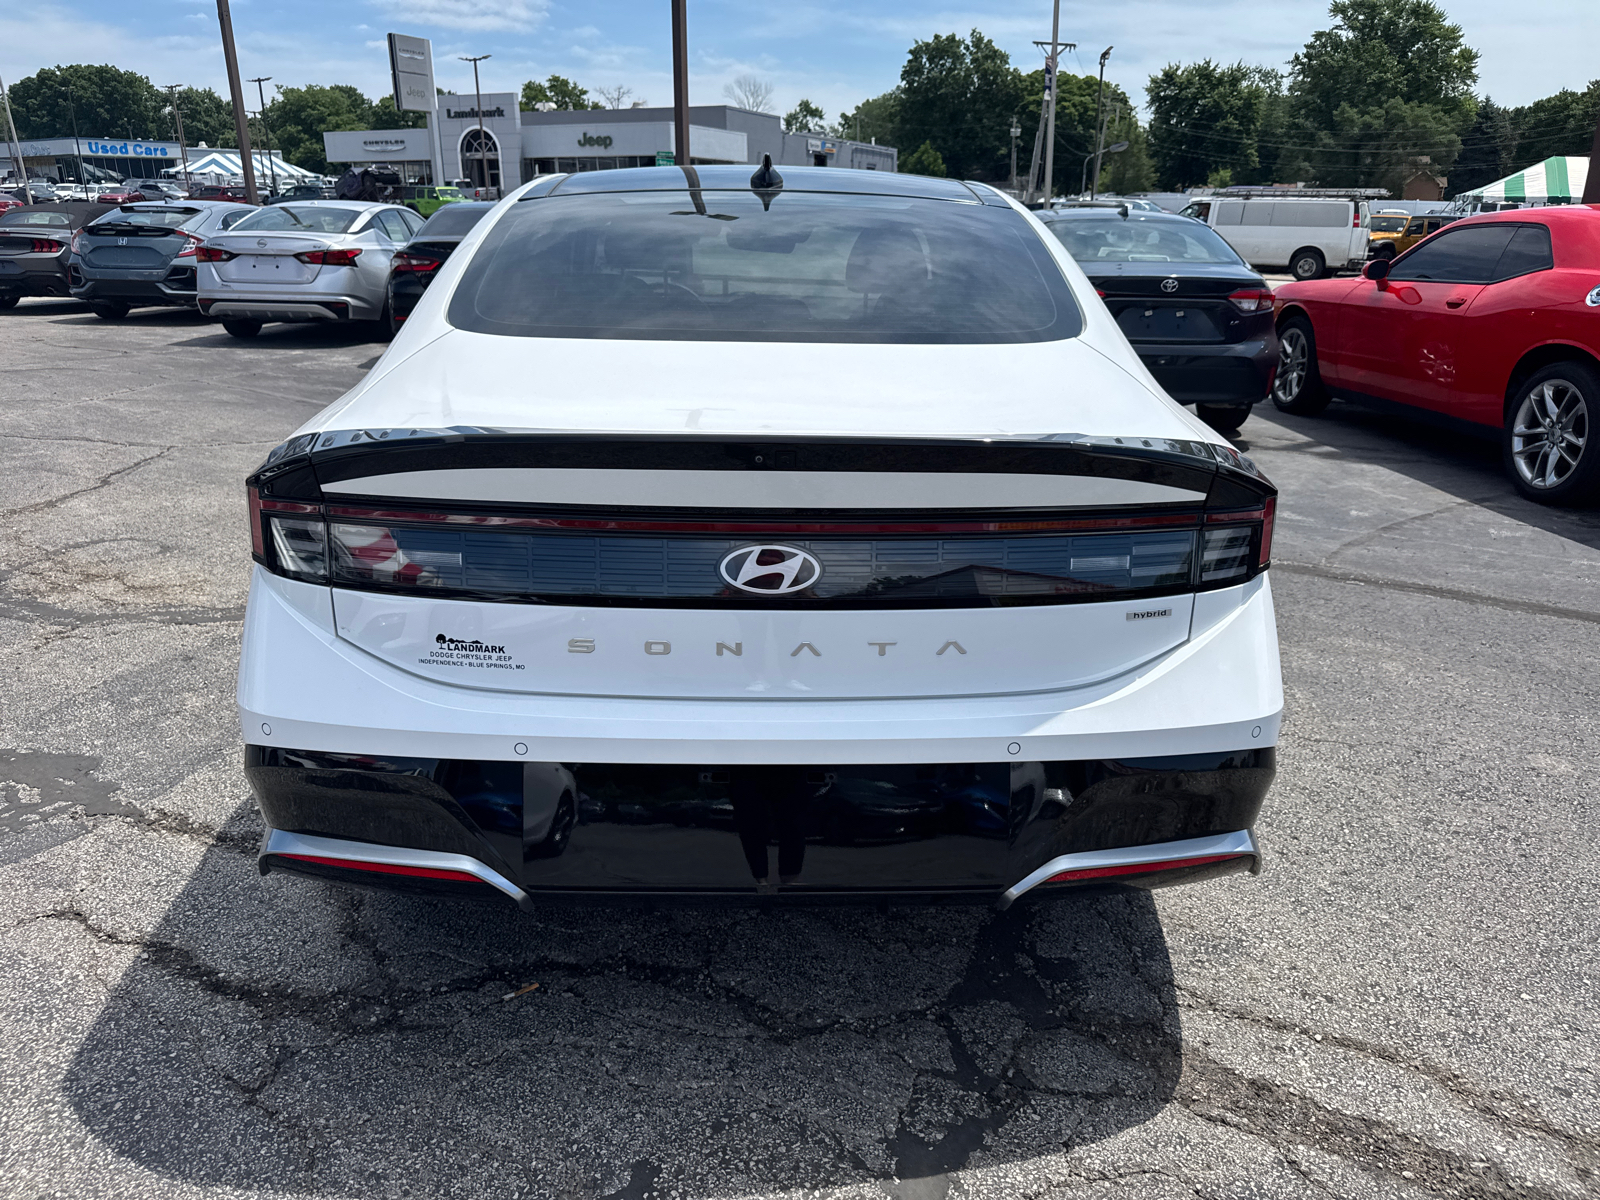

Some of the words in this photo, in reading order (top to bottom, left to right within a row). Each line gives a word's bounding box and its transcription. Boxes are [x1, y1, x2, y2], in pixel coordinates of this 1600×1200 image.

[406, 86, 426, 99] Jeep
[446, 107, 505, 119] Landmark
[577, 132, 613, 150] Jeep
[88, 141, 129, 154] Used
[132, 143, 168, 156] Cars
[1133, 609, 1167, 619] hybrid
[447, 643, 506, 654] LANDMARK
[430, 651, 455, 659] DODGE
[456, 653, 493, 661] CHRYSLER
[418, 659, 464, 667] INDEPENDENCE
[485, 663, 515, 671] SPRINGS,
